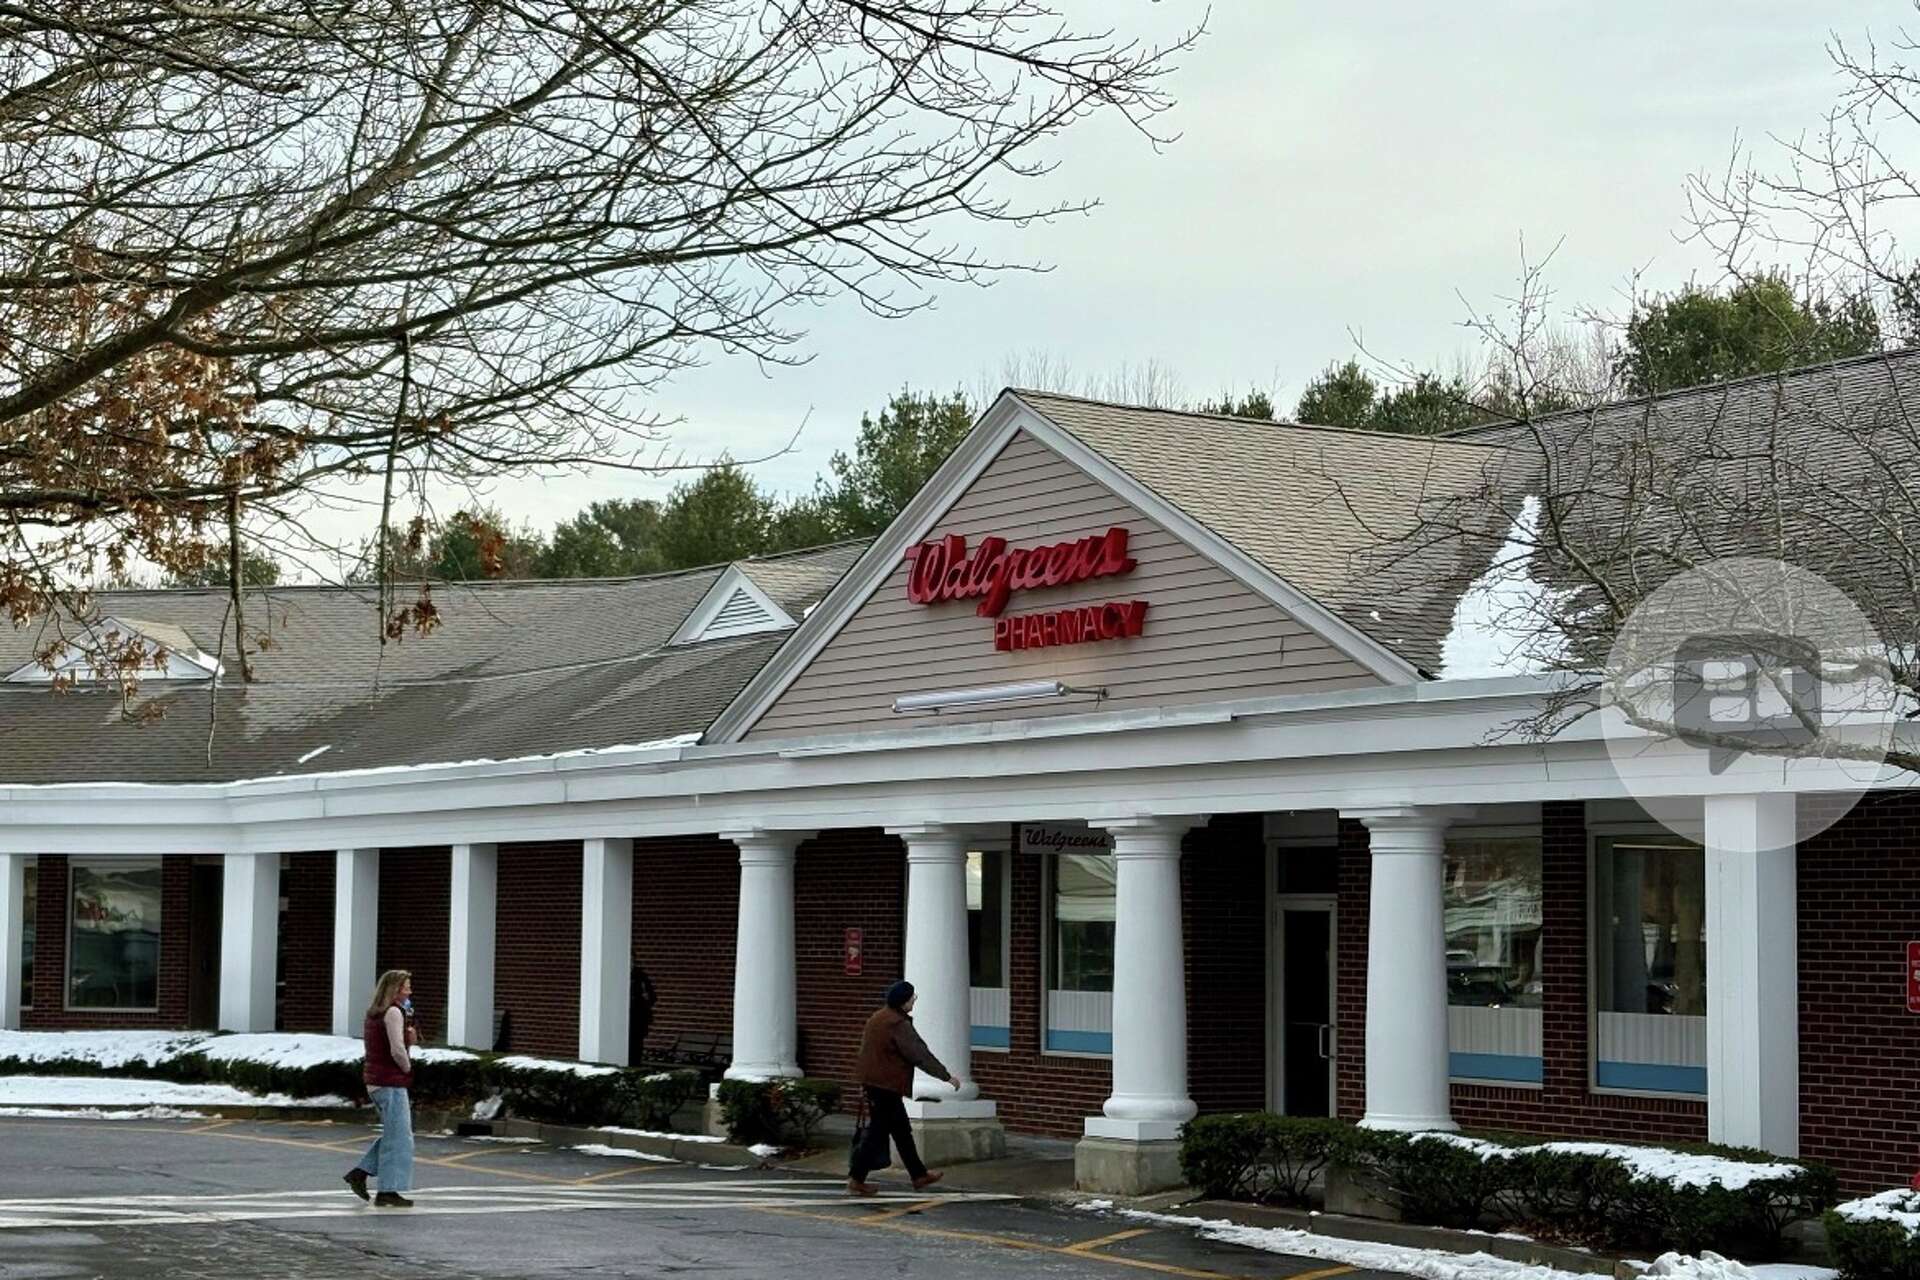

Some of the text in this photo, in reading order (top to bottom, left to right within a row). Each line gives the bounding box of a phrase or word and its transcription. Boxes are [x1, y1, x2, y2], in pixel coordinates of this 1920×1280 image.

[904, 527, 1138, 617] Walgreens
[994, 600, 1150, 651] PHARMACY
[1025, 828, 1108, 852] Walgreens
